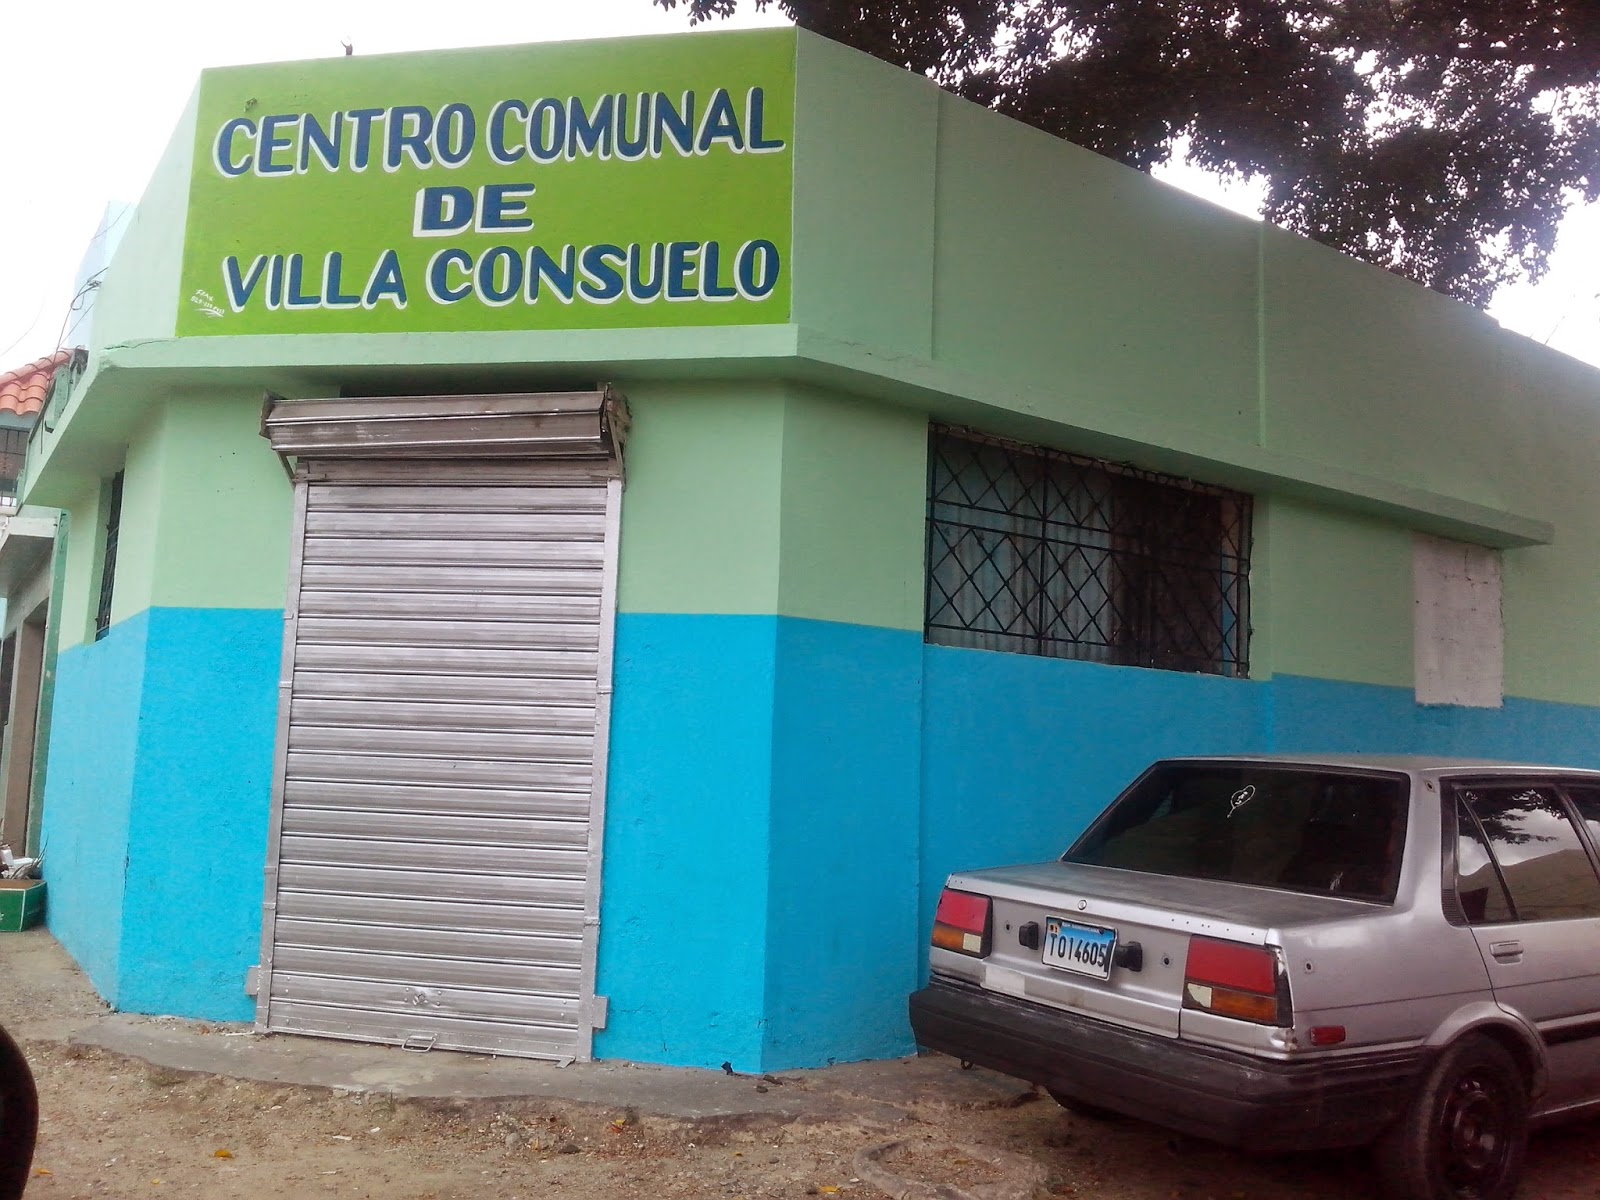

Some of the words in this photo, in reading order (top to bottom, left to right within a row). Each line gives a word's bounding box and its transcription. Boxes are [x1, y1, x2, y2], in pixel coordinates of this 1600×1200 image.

[214, 103, 475, 177] CENTRO
[487, 88, 785, 164] COMUNAL
[412, 183, 537, 238] DE
[223, 250, 407, 312] VILLA
[425, 239, 781, 308] CONSUELO
